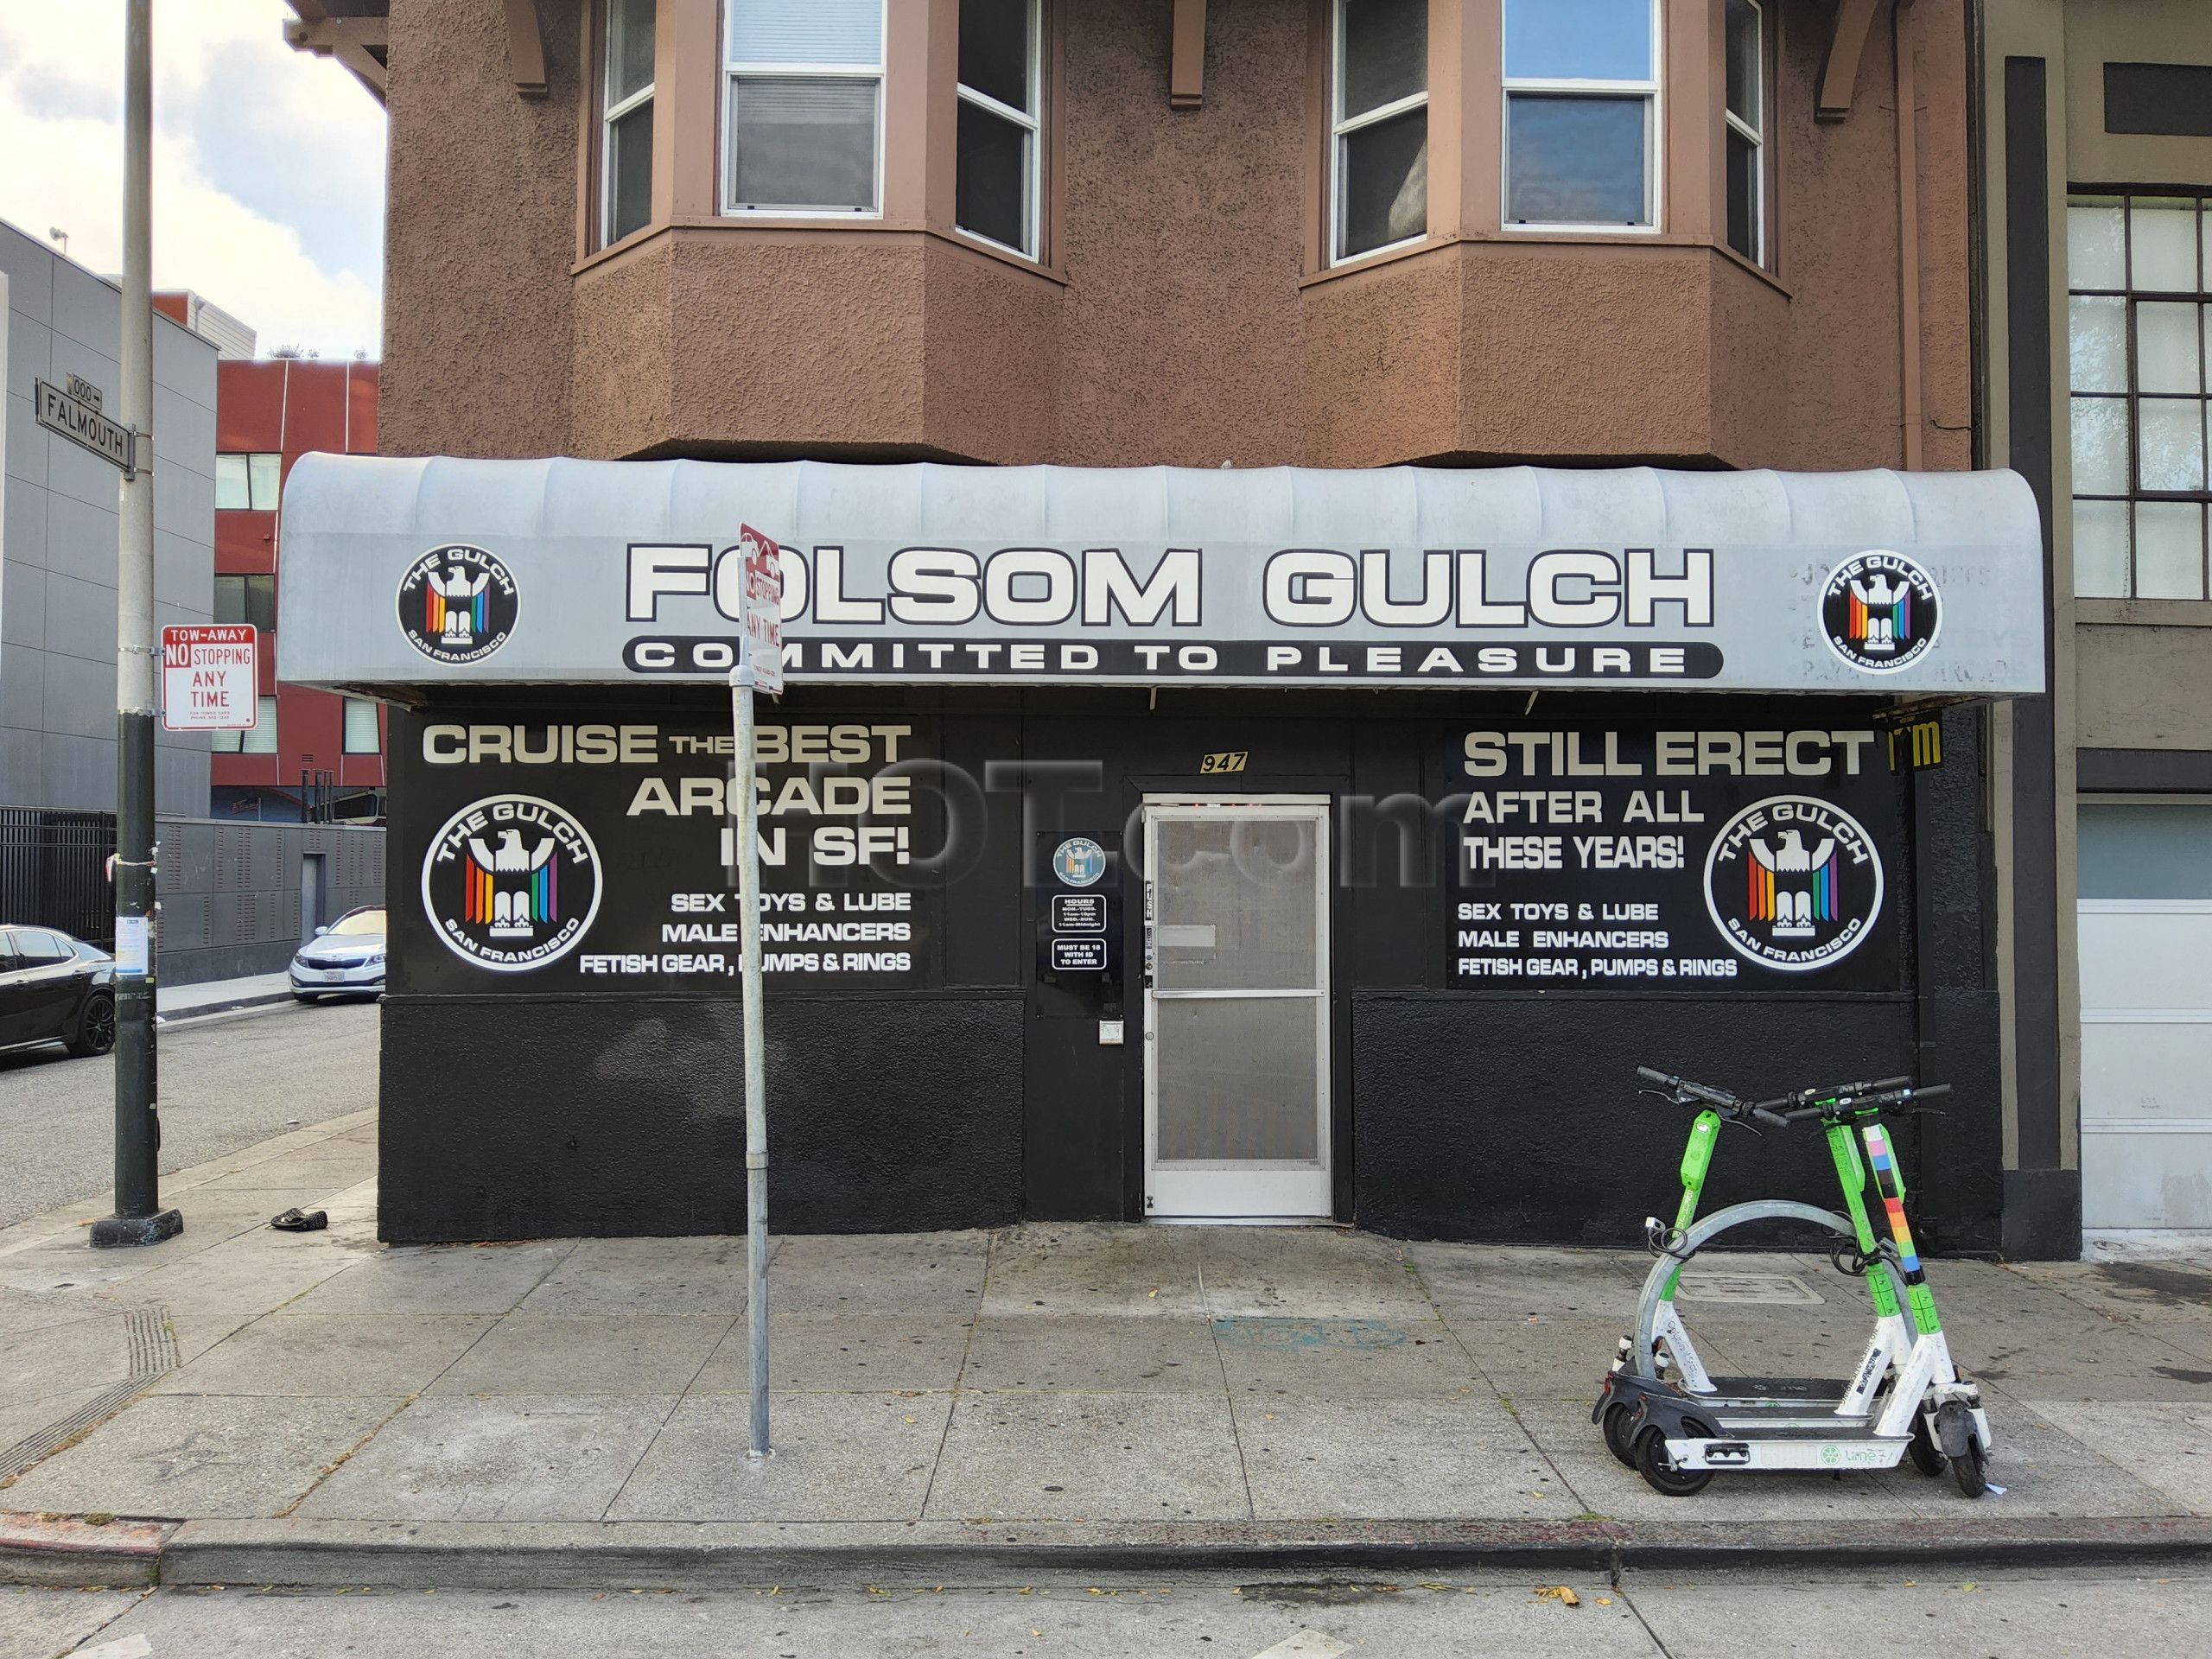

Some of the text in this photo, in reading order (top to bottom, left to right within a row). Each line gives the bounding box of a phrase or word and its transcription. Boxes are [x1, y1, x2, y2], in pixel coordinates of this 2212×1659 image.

[48, 393, 123, 457] FALMOUTH
[403, 548, 515, 596] THE GULCH
[1263, 548, 1713, 628] GULCH
[1827, 556, 1933, 601] THE GULCH
[170, 629, 247, 641] TOW-AWAY
[408, 629, 506, 661] SAN FRANCISCO
[763, 618, 779, 648] TIME
[166, 643, 251, 666] NO STOPPING
[1135, 644, 1218, 671] TO
[1267, 646, 1686, 673] PLEASURE
[1834, 636, 1927, 668] SAN FRANCISCO
[193, 671, 226, 687] ANY
[190, 691, 230, 708] TIME
[423, 724, 912, 764] CRUISE THE BEST
[1464, 730, 1643, 777] STILL
[1655, 730, 1875, 775] ERECT
[1203, 753, 1247, 772] 947
[626, 777, 912, 816] ARCADE
[1463, 790, 1705, 824] AFTER ALL
[436, 803, 589, 864] THE GULCH
[721, 826, 910, 866] IN SF!
[1057, 840, 1102, 858] THE GULCH
[1718, 803, 1870, 865] THE GULCH
[1463, 835, 1685, 870] THESE YEARS!
[671, 893, 726, 912] SEX
[815, 893, 836, 912] &
[843, 892, 912, 912] LUBE
[1458, 903, 1659, 921] SEX TOYS & LUBE
[445, 917, 580, 963] SAN FRANCISCO
[662, 922, 911, 943] MALE NHANCERS
[1459, 931, 1669, 949] MALE ENHANCERS
[1726, 917, 1863, 963] SAN FRANCISCO
[580, 954, 658, 973] FETISH
[738, 953, 819, 973] UMPS
[822, 953, 840, 972] &
[842, 952, 912, 972] RINGS
[1459, 958, 1522, 976] FETISH
[1591, 958, 1659, 976] PUMPS
[1662, 958, 1678, 976] &
[1680, 958, 1738, 976] RINGS
